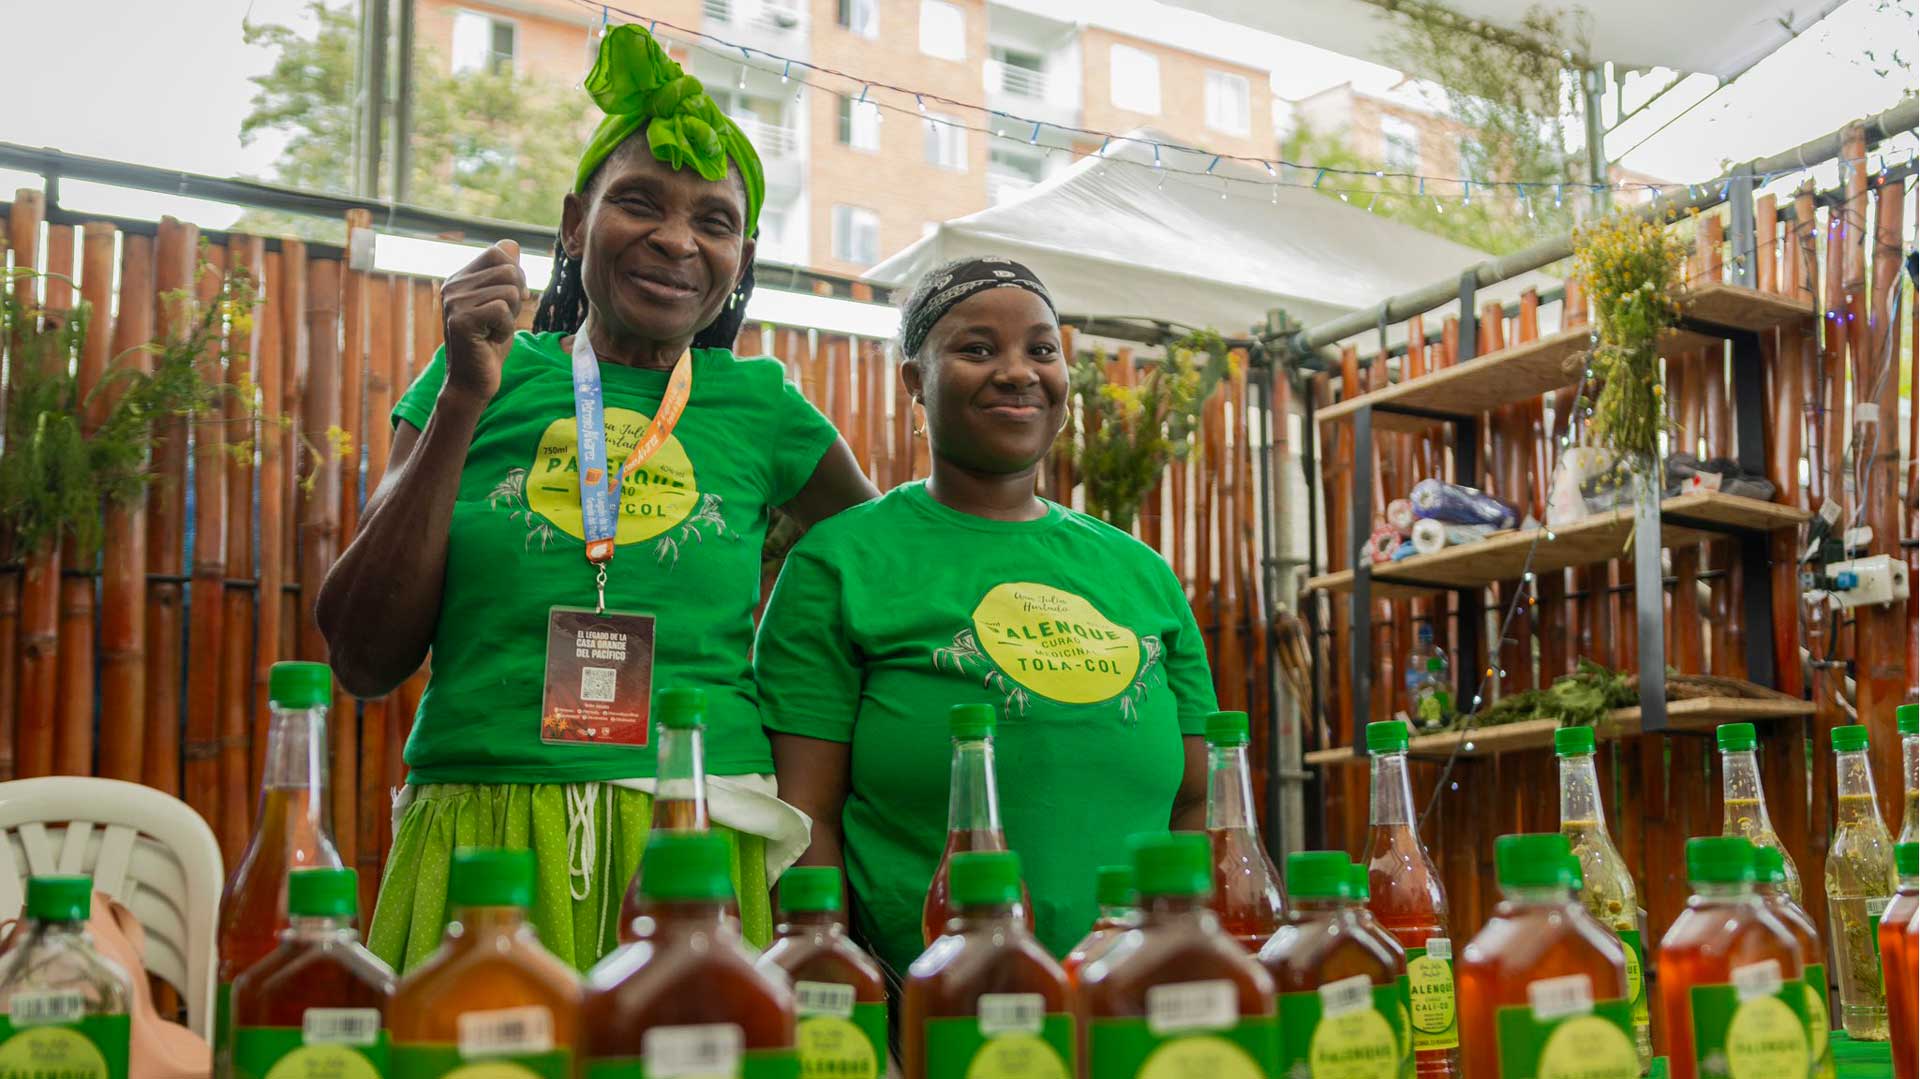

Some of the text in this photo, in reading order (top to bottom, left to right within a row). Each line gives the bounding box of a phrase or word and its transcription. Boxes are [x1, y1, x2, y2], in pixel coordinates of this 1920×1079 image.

[619, 423, 645, 438] Juli
[604, 432, 641, 450] urtad
[585, 631, 609, 640] LEGADO
[610, 633, 618, 641] DE
[619, 633, 627, 641] LA
[1005, 620, 1121, 640] ALENQUE
[576, 638, 626, 650] CASA GRANDE
[576, 648, 590, 658] DEL
[1018, 658, 1121, 674] TOLA-COL
